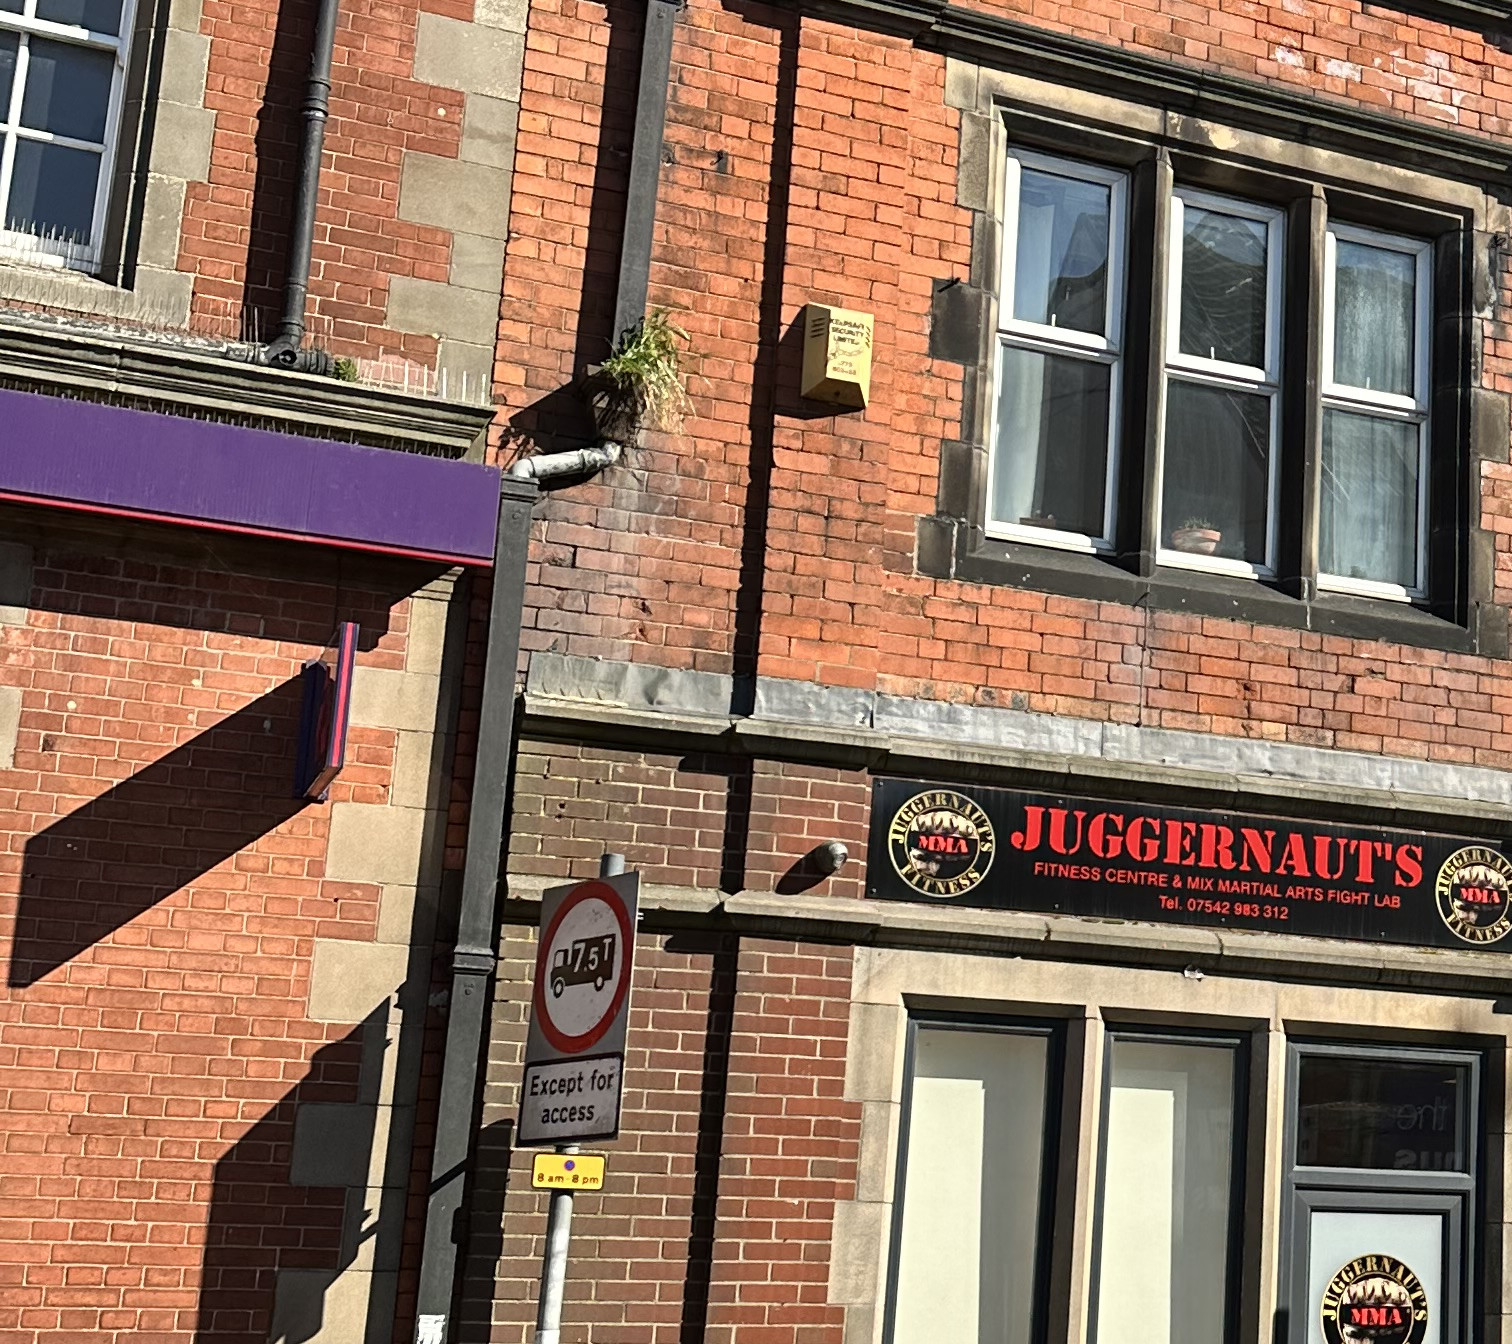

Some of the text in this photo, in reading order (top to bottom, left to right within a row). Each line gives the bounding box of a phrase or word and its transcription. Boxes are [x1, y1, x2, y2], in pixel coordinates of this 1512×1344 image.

[890, 792, 994, 853] JUGGERNAUT'S
[918, 834, 969, 854] MMA
[1010, 805, 1424, 888] JUGGERNAUT'S
[900, 864, 981, 896] FITNESS
[1034, 861, 1402, 909] FITNESS CENTRE & MIX MARTIAL ARTS FIGHT LAB
[1158, 895, 1289, 920] Tel. 07542 983 312
[1460, 887, 1501, 904] MMA
[1446, 912, 1512, 941] FITNESS
[530, 1070, 615, 1098] Except for
[540, 1104, 596, 1125] access
[1322, 1255, 1429, 1322] JUGGERNAUT'S
[1351, 1308, 1403, 1326] MMA
